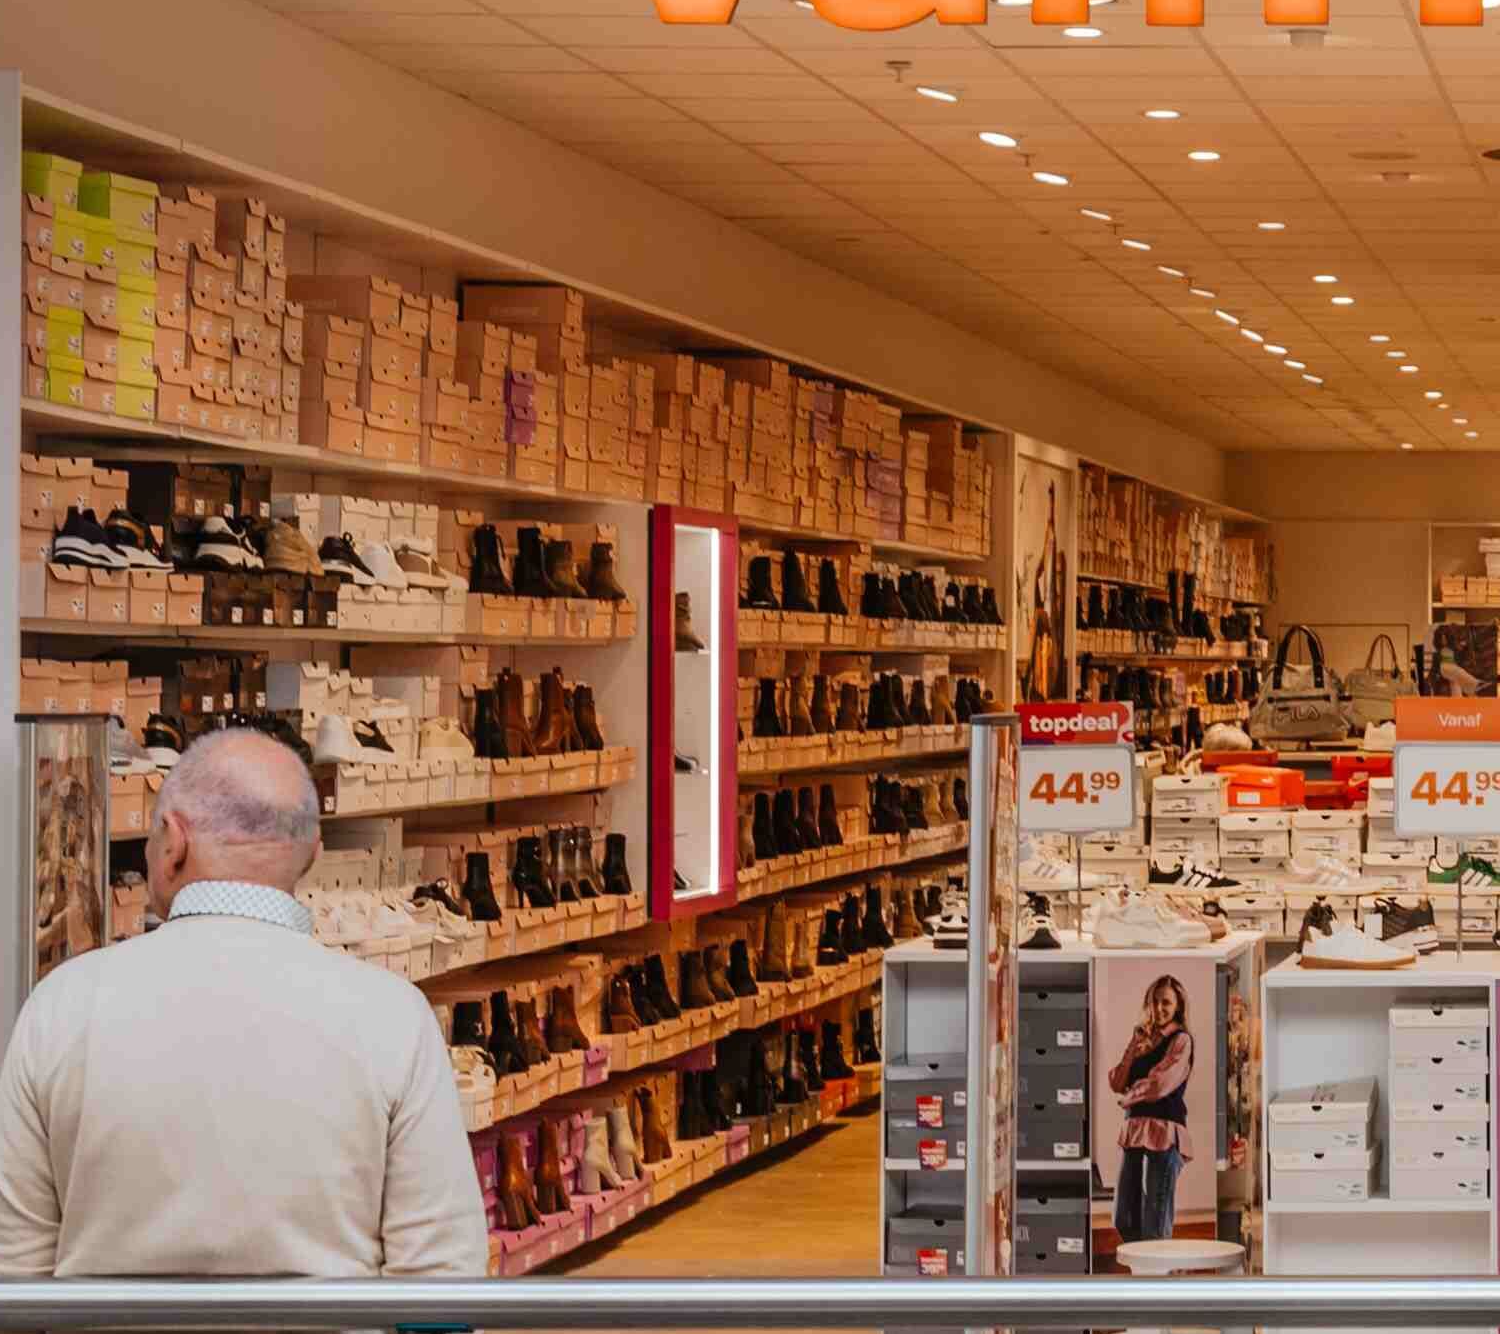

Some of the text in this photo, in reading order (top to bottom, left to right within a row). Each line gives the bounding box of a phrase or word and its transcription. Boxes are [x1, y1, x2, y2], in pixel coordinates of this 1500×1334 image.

[1029, 711, 1119, 736] topdeal
[1437, 711, 1482, 729] Vanaf
[1029, 771, 1121, 805] 44.99
